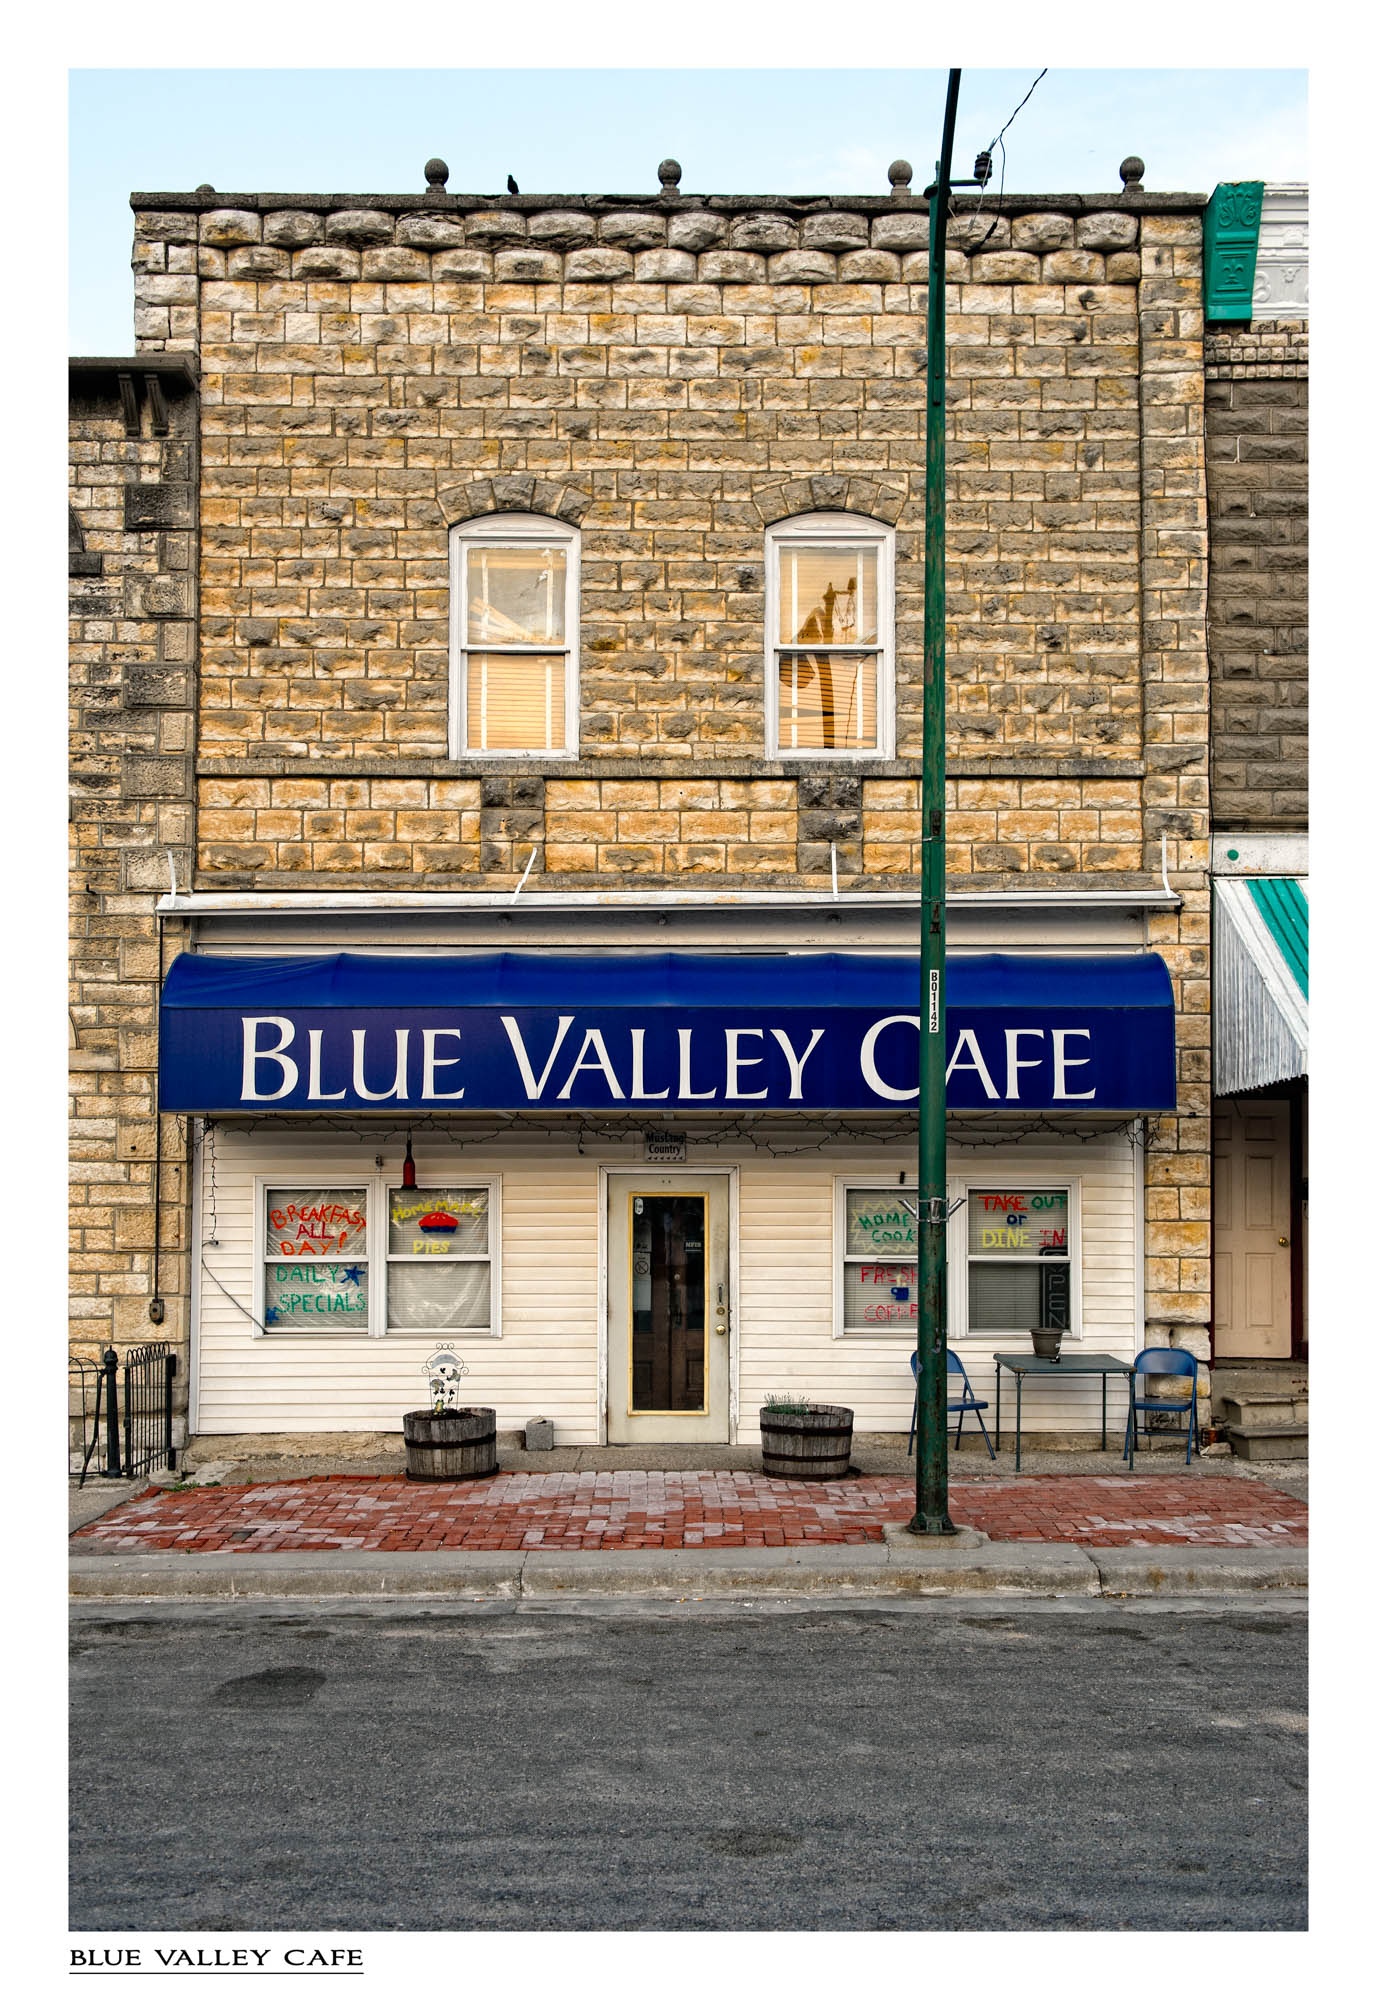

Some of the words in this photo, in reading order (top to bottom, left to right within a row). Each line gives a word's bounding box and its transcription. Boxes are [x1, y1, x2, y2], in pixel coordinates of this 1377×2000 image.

[240, 1016, 465, 1101] BLUE
[501, 1015, 826, 1100] VALLEY
[860, 1015, 1097, 1101] CAFE
[646, 1131, 684, 1144] Mustang
[649, 1144, 680, 1156] Country
[977, 1195, 1028, 1211] TAKE
[1031, 1196, 1068, 1210] OUT
[270, 1204, 367, 1232] BREAKFAST
[858, 1212, 910, 1230] HOME
[1006, 1214, 1027, 1225] or
[296, 1221, 335, 1240] ALL
[872, 1229, 918, 1242] COOK
[982, 1228, 1032, 1248] DINE
[1039, 1228, 1065, 1247] IN
[280, 1232, 348, 1255] DAY!
[412, 1240, 451, 1255] PIES
[276, 1265, 339, 1282] DAILY
[276, 1293, 366, 1312] SPECIALS
